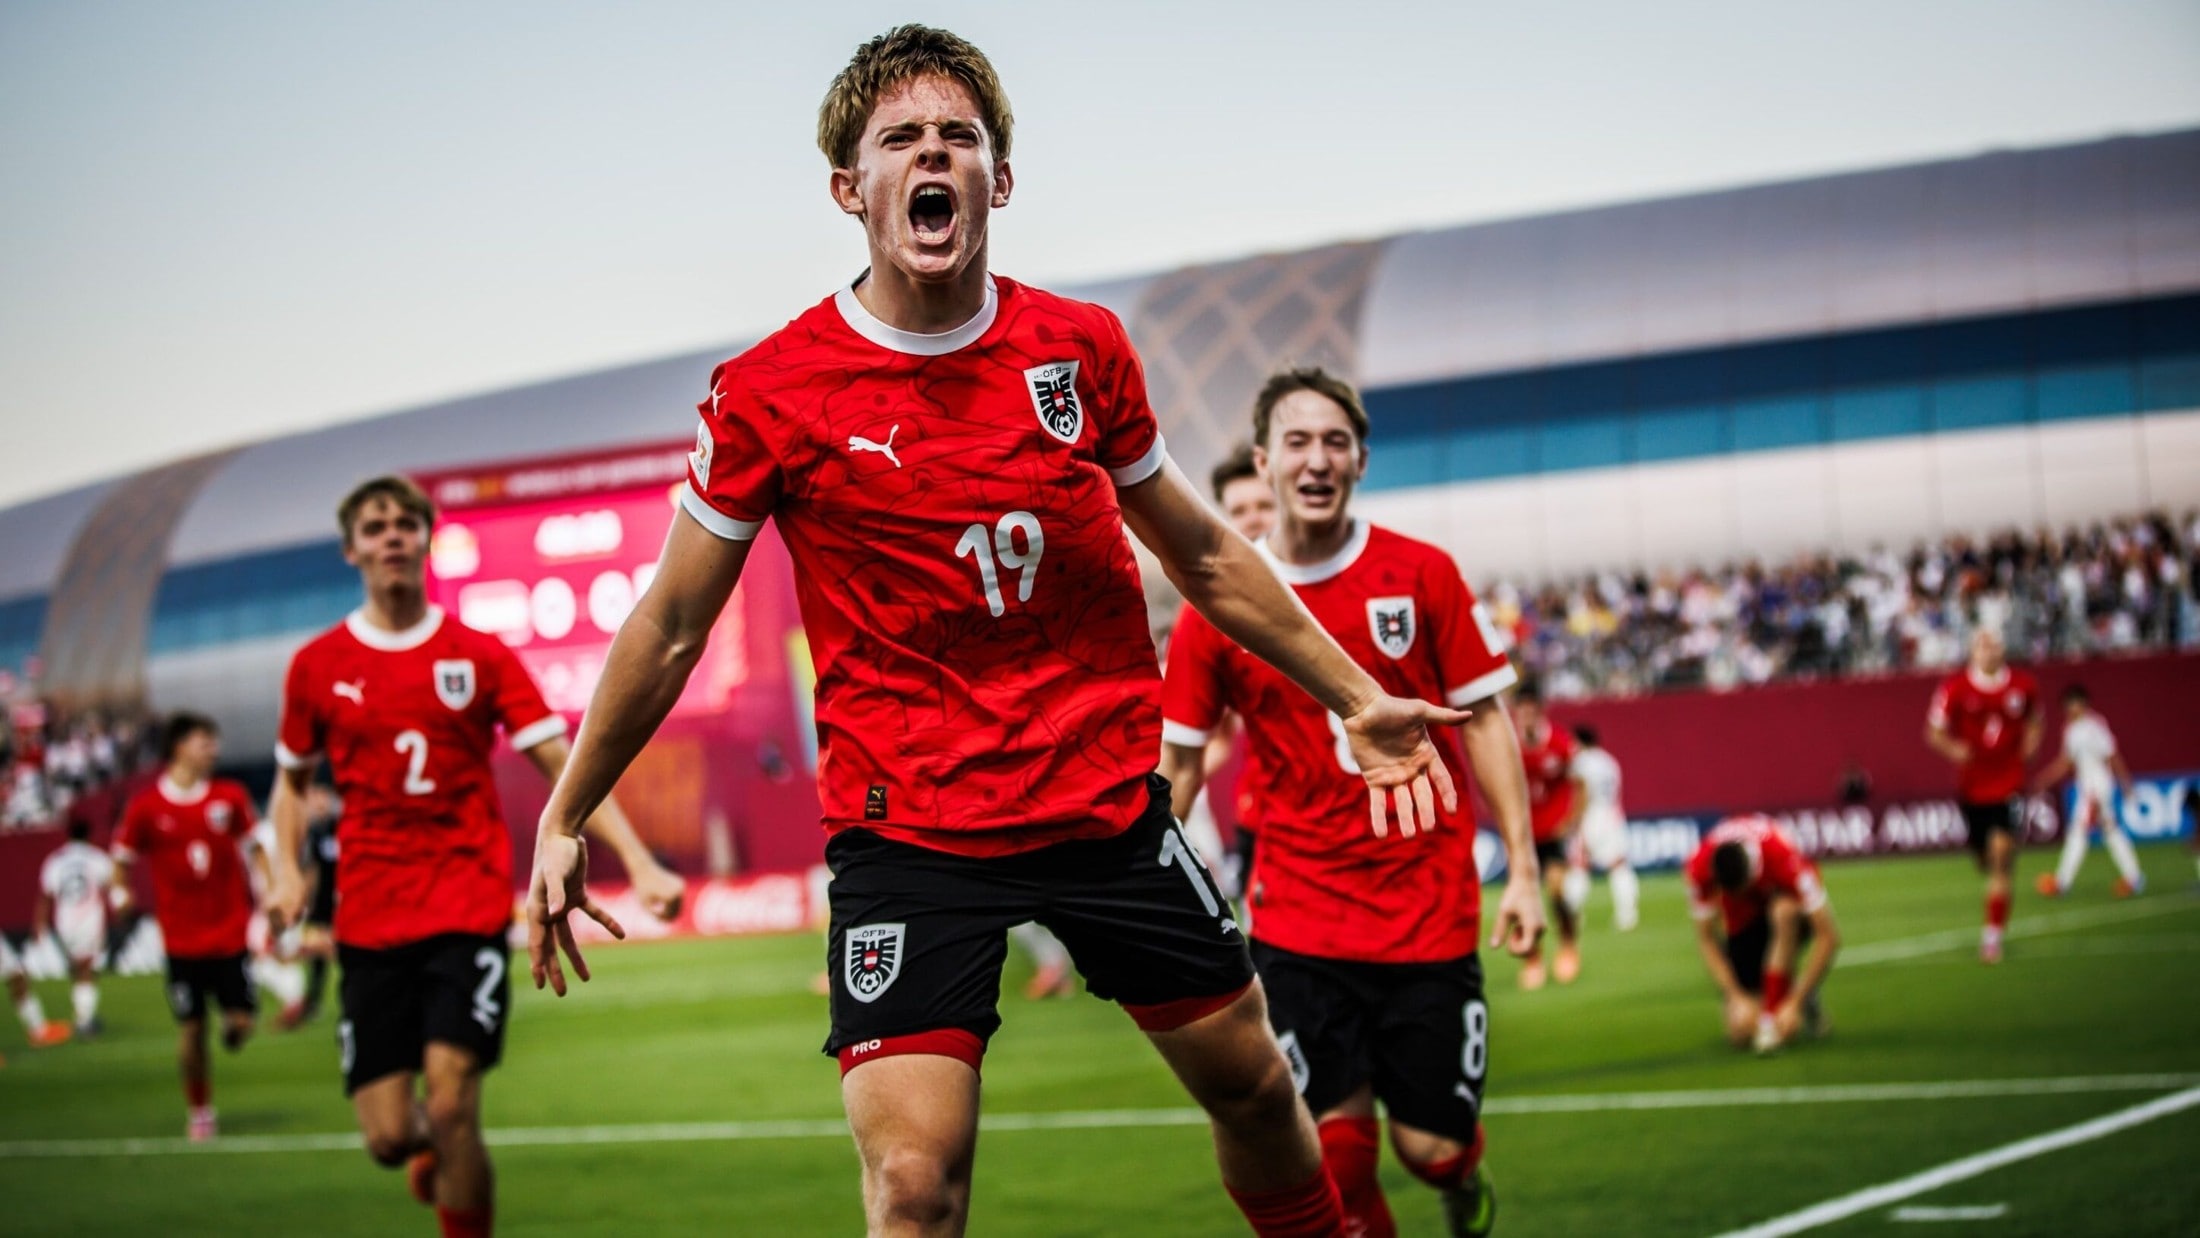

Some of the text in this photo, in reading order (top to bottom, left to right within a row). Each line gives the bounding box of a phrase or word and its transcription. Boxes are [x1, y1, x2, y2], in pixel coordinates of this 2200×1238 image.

[1042, 366, 1062, 378] ÖFB
[955, 510, 1045, 617] 19
[393, 728, 437, 796] 2
[861, 929, 886, 938] ÖFB
[474, 946, 505, 1015] 2
[851, 1038, 882, 1057] PRO
[1461, 1000, 1487, 1079] 8
